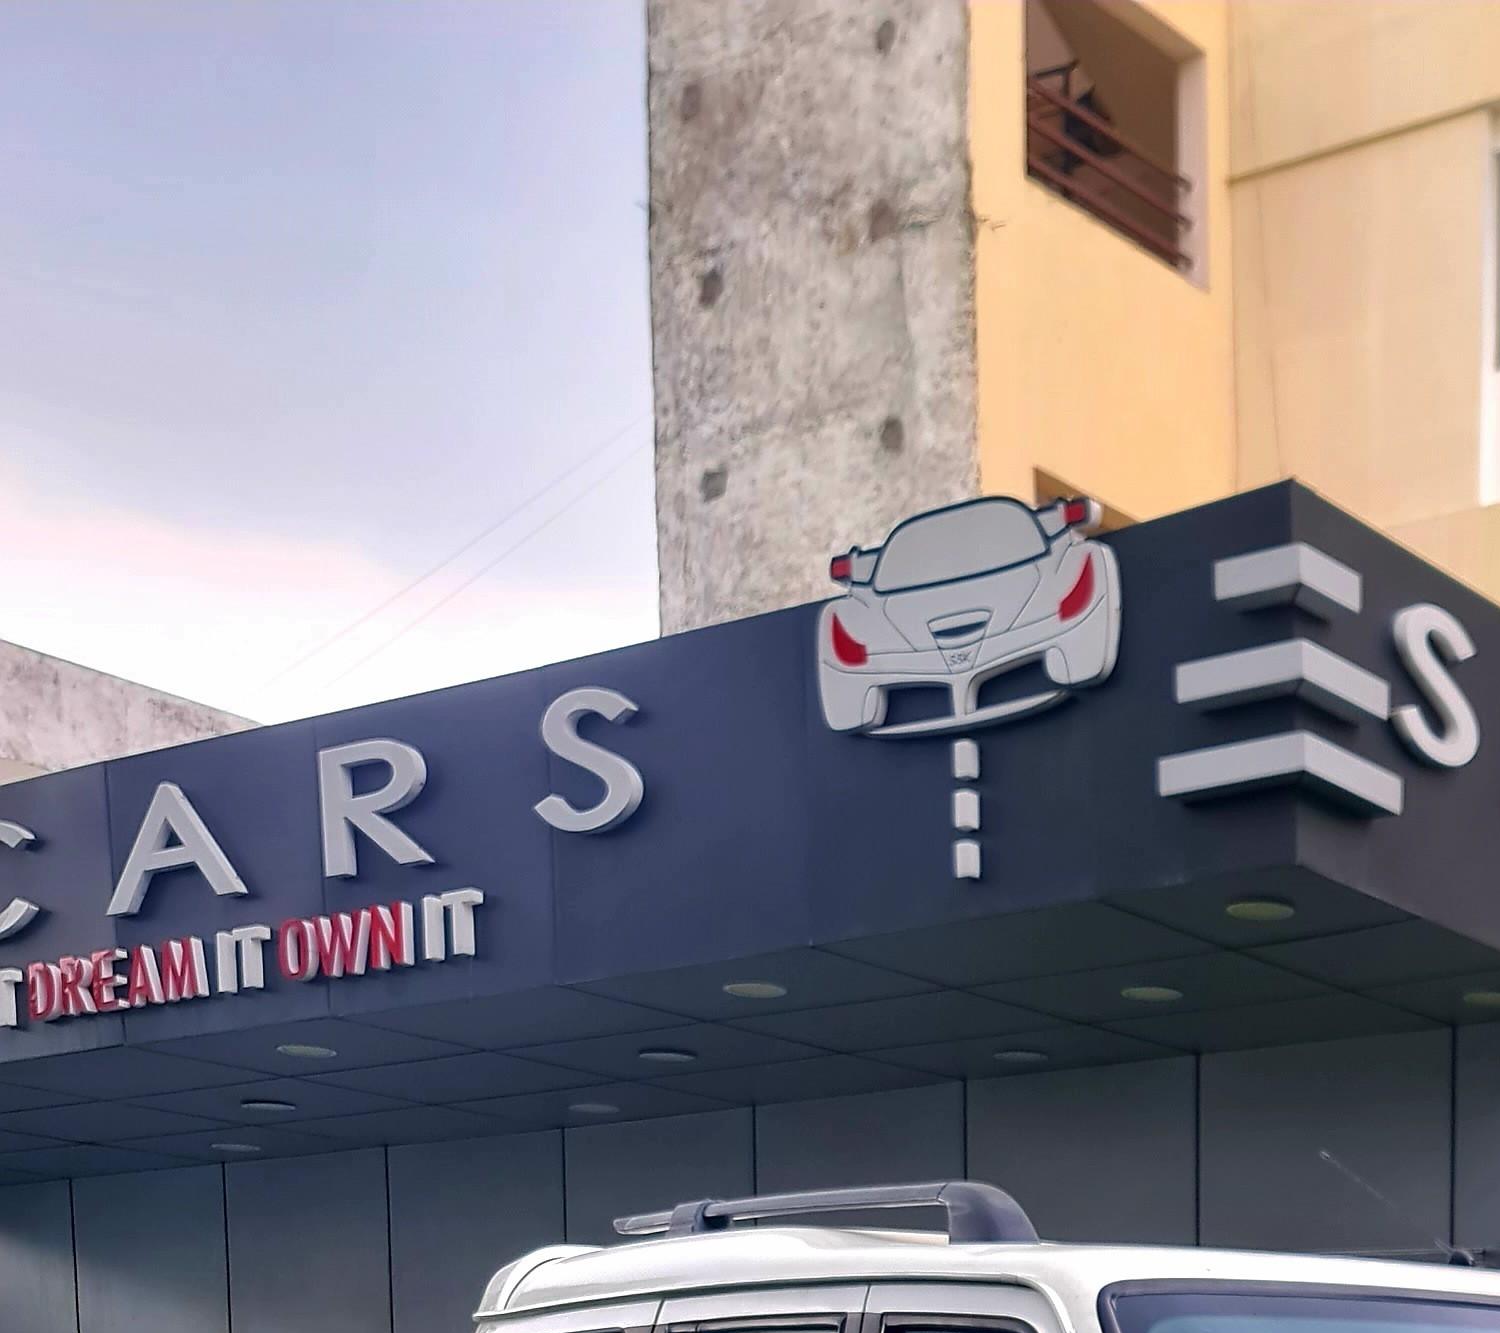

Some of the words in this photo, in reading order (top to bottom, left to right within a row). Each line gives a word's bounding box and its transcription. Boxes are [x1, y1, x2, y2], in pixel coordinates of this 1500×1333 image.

[27, 935, 210, 1021] DREAM
[216, 924, 271, 994] IT
[277, 900, 415, 982] OWN
[422, 887, 484, 962] IT
